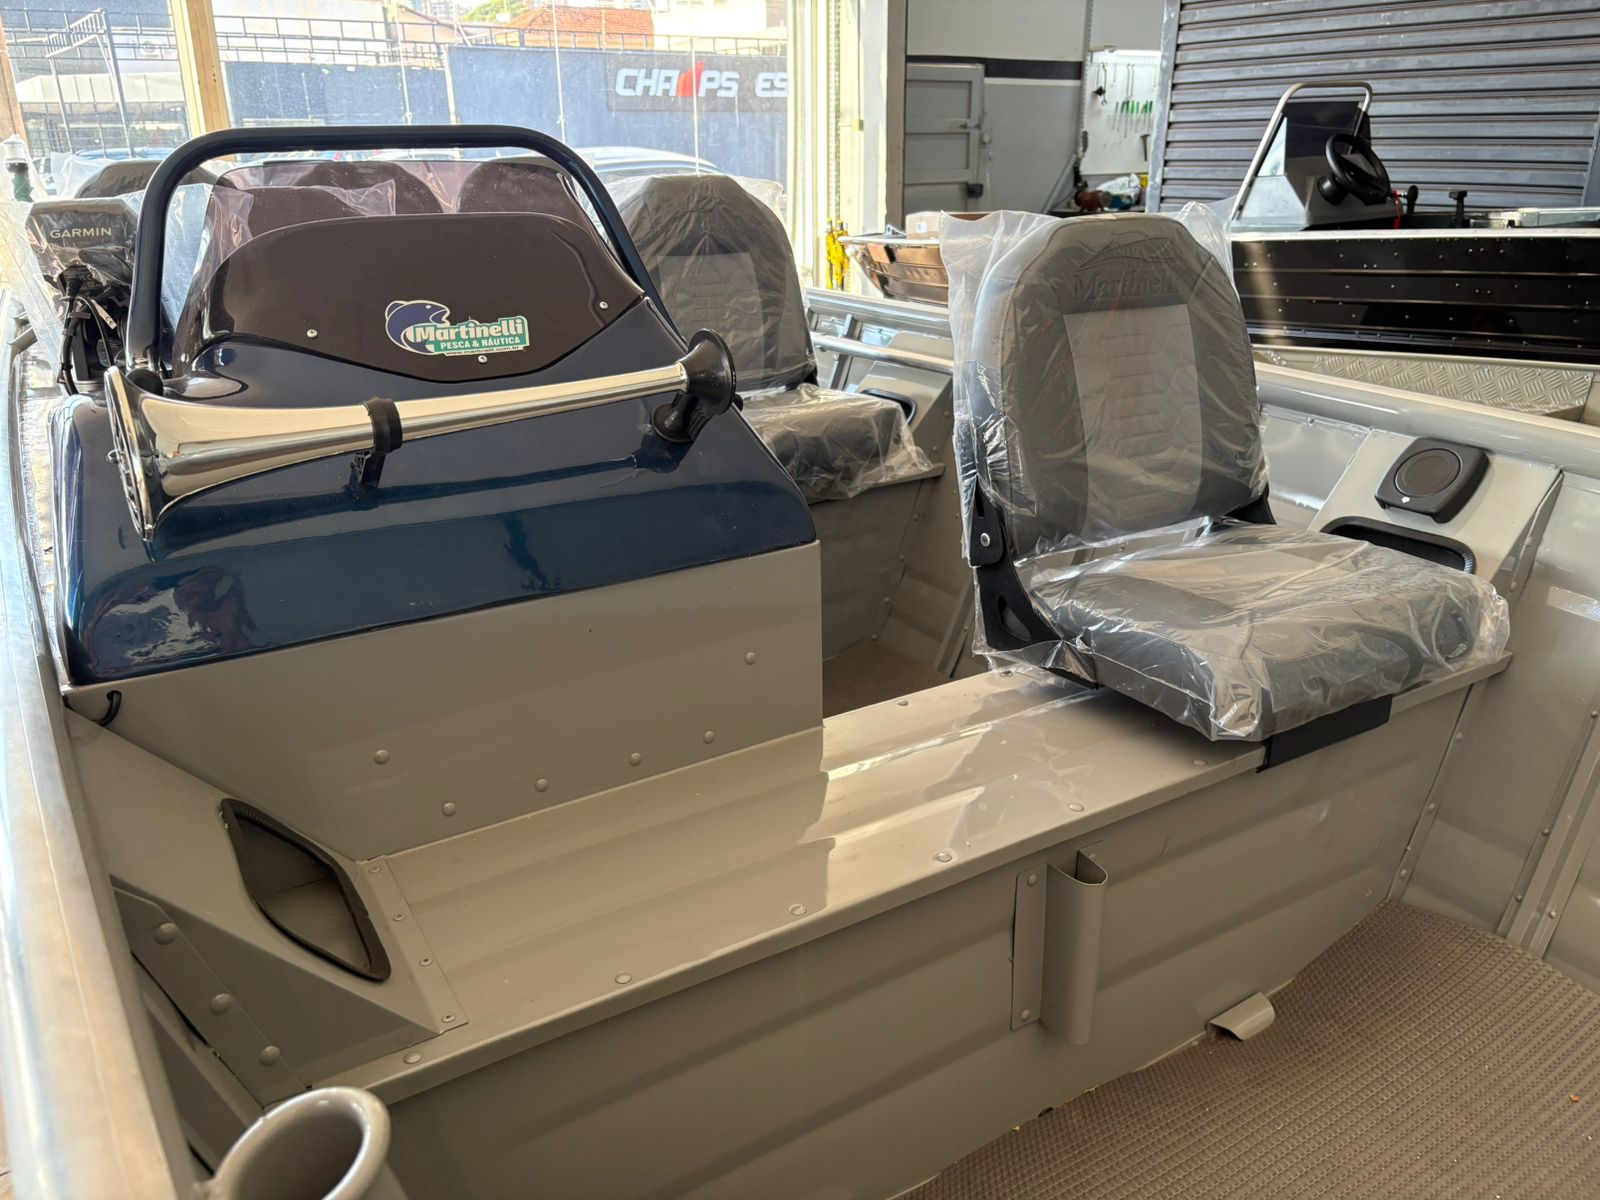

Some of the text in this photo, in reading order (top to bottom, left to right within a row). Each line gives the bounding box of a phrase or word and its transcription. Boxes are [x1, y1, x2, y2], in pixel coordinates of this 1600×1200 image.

[50, 227, 112, 238] GARMIN
[415, 319, 523, 342] Martinelli
[440, 341, 471, 350] PESCA
[481, 336, 520, 347] NÁUTICA
